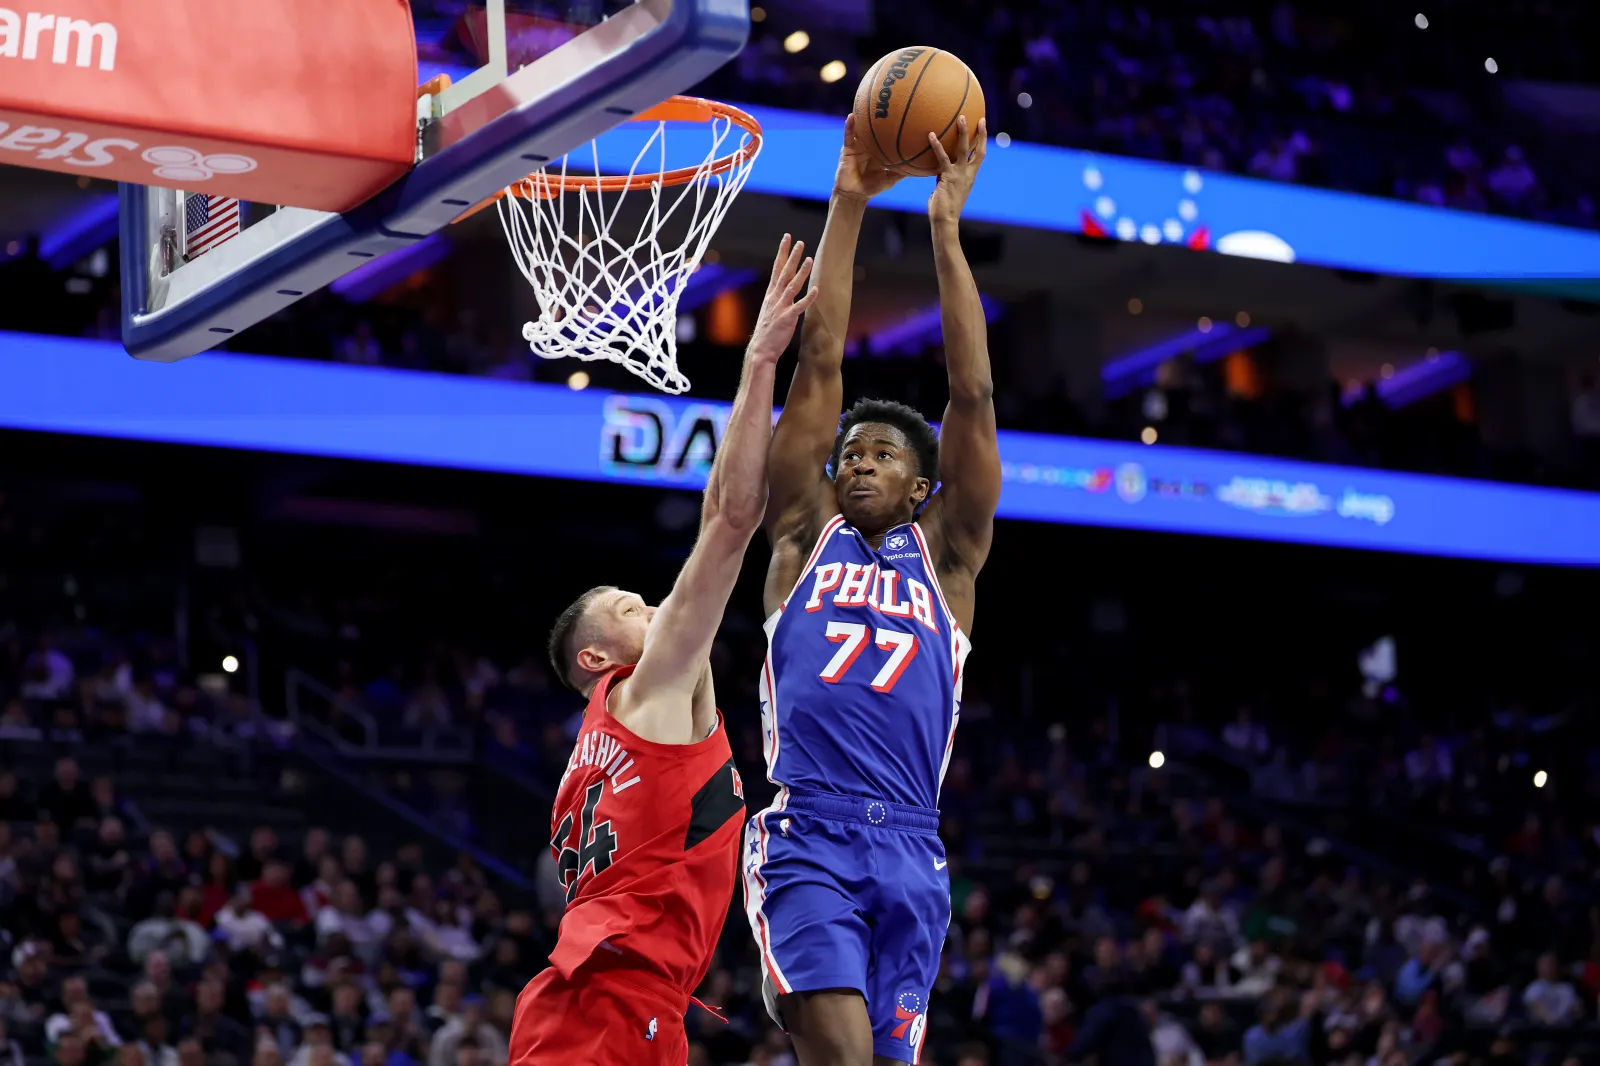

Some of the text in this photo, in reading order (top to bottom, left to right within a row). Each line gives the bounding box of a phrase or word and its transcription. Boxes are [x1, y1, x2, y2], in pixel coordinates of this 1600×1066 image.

[875, 49, 927, 119] Wilson
[0, 121, 140, 167] Sta
[883, 552, 921, 561] rypto.com
[805, 561, 939, 635] PHILA
[819, 620, 919, 694] 77
